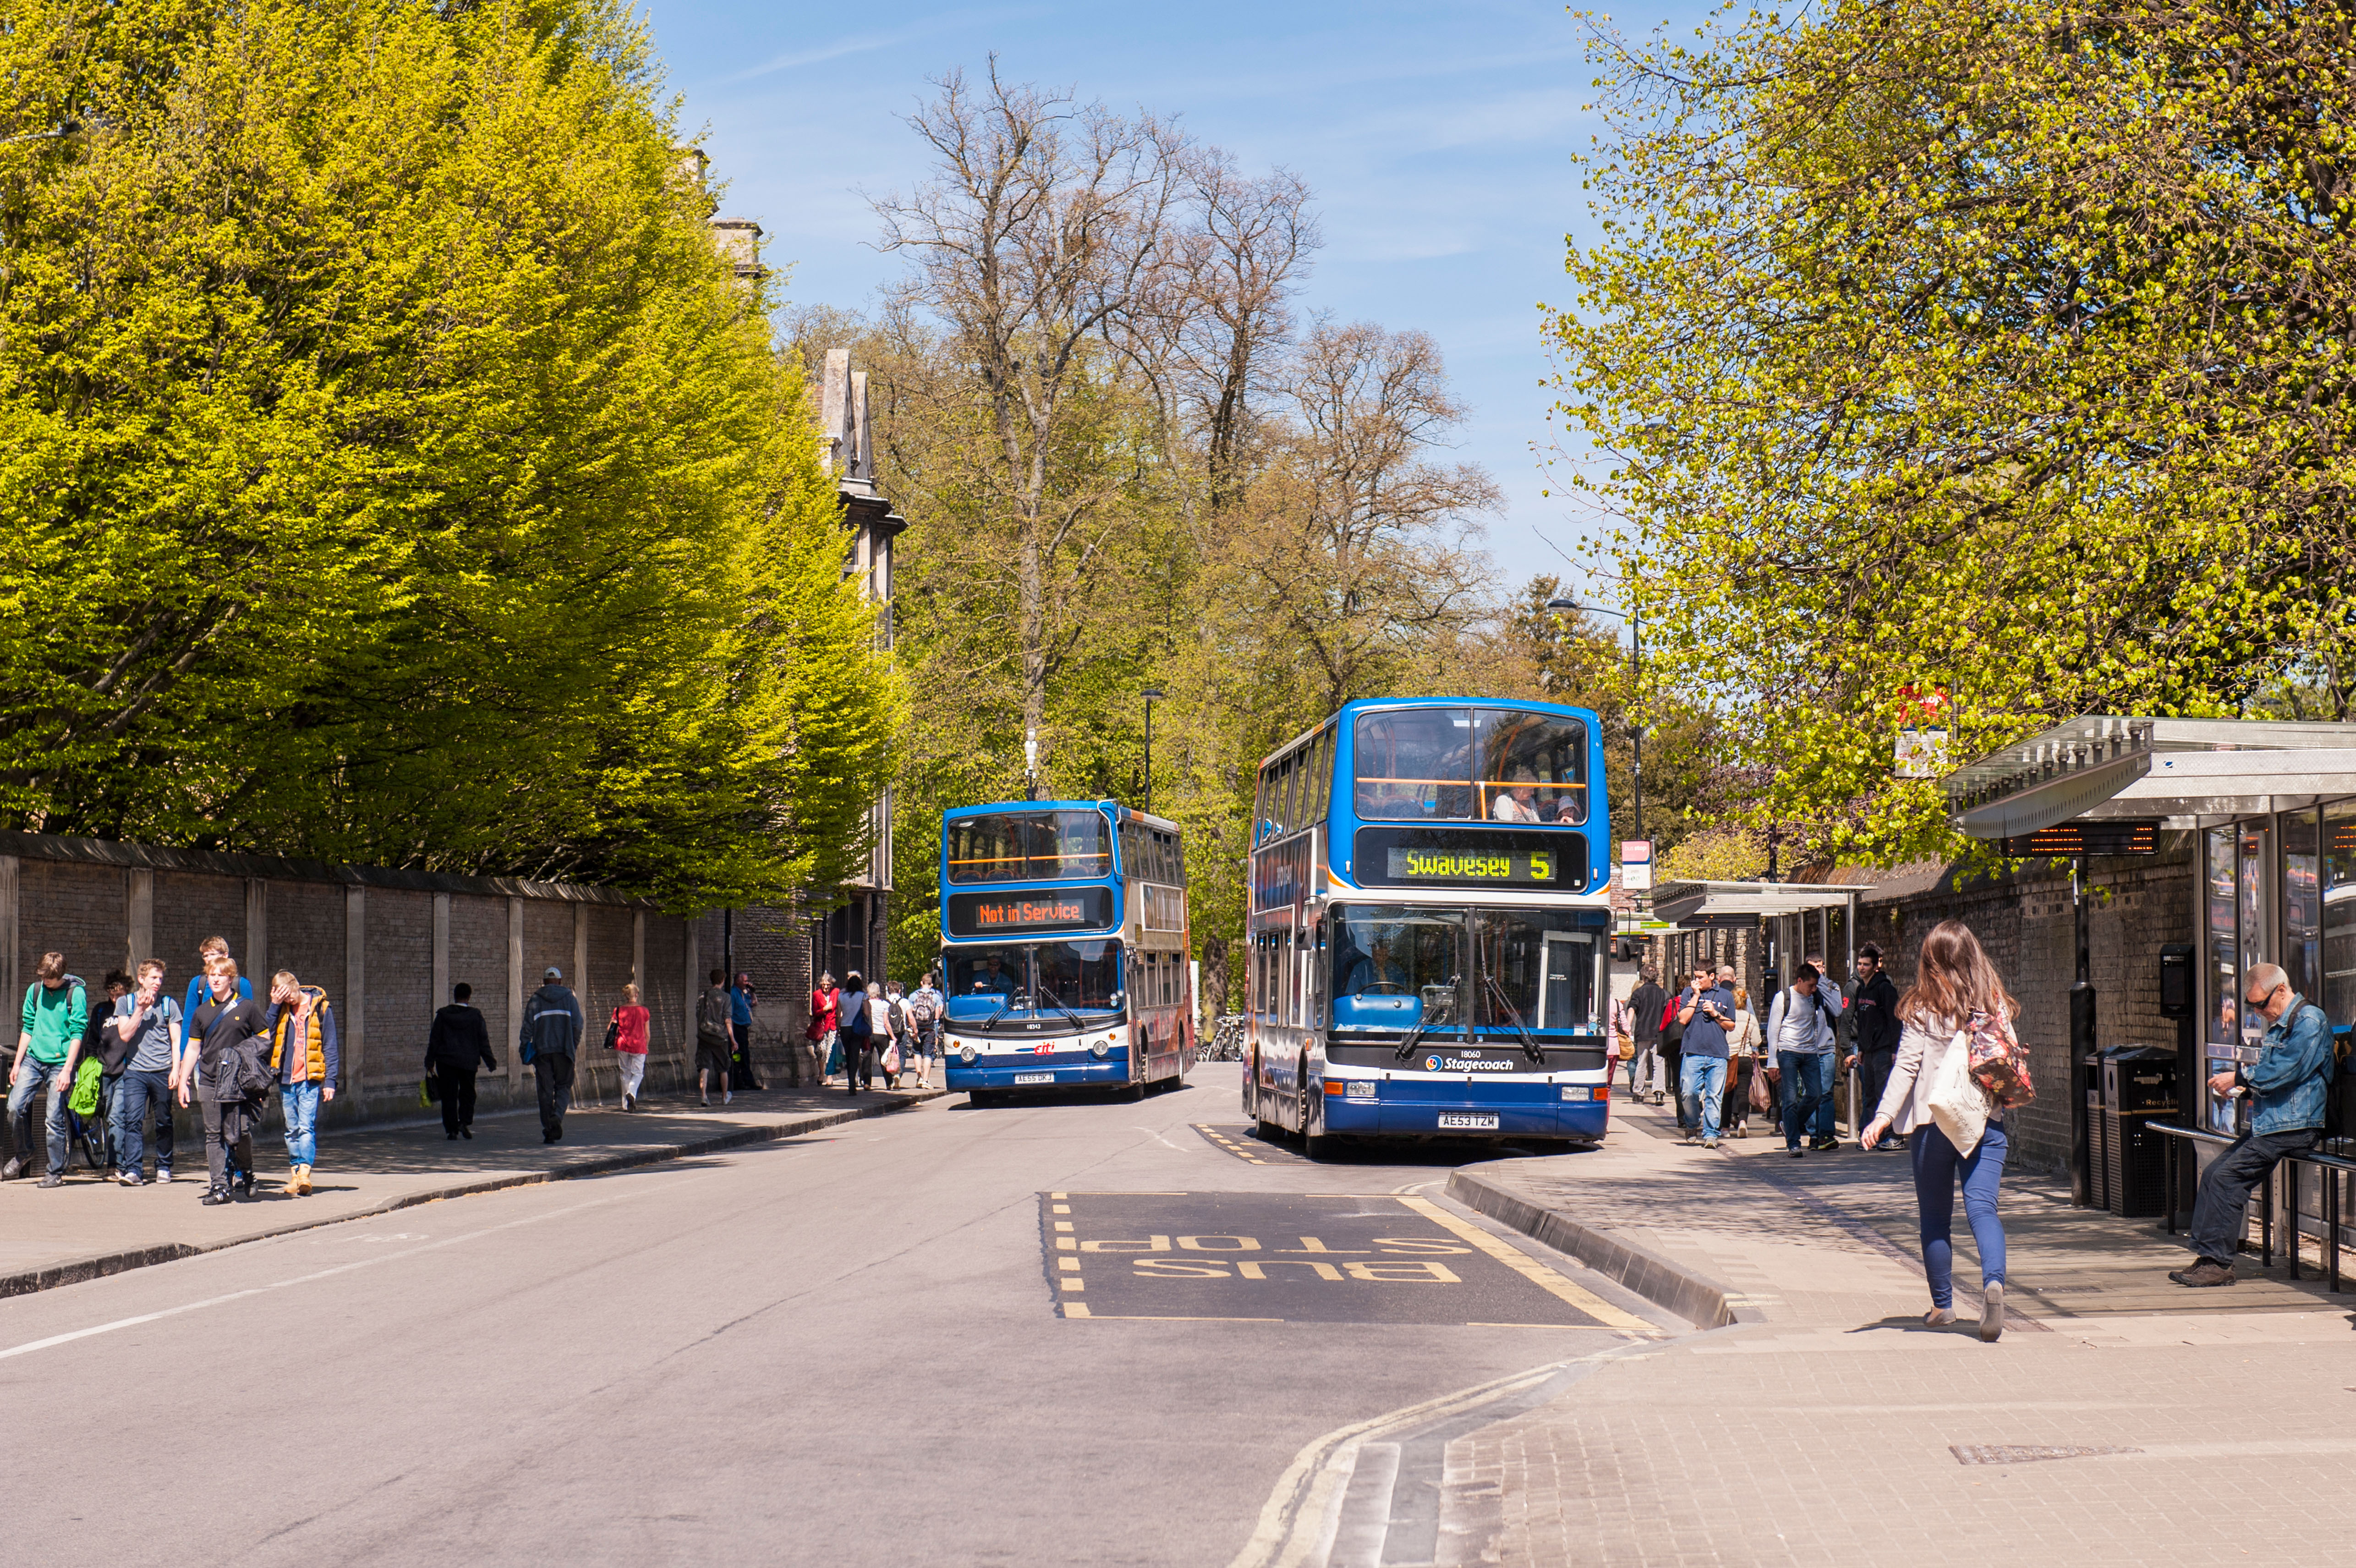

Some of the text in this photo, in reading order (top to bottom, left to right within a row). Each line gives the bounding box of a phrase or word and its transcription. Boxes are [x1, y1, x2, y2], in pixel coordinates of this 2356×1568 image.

[1407, 850, 1549, 879] Swavesey 5
[980, 903, 1079, 923] Not in Service
[1034, 1041, 1055, 1055] citi
[1444, 1058, 1514, 1072] Stagecoach
[1443, 1116, 1495, 1126] AE53 TZM
[1080, 1234, 1473, 1255] STOP
[1133, 1258, 1463, 1283] BUS
